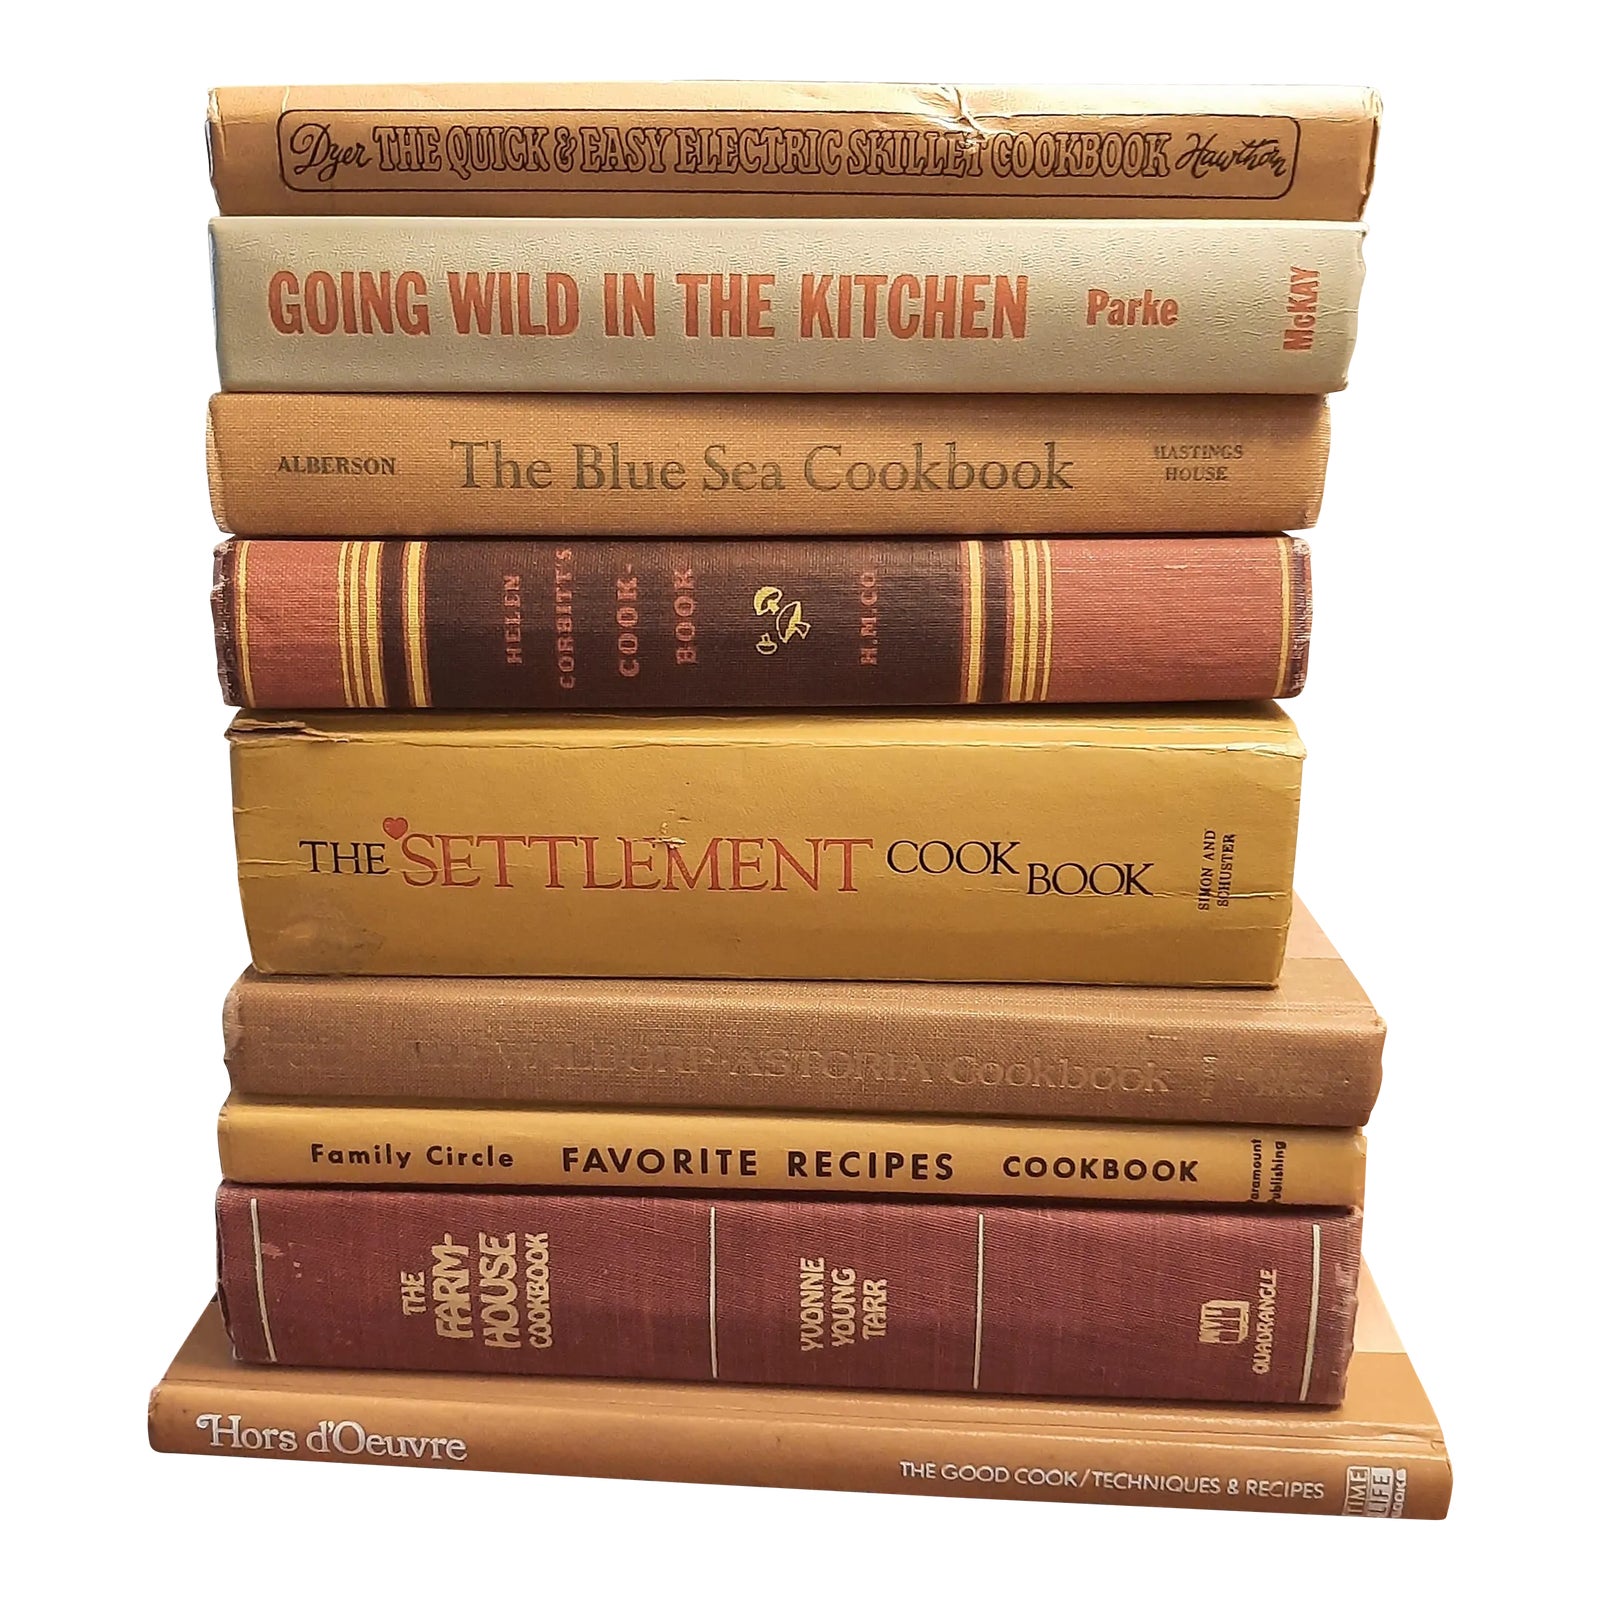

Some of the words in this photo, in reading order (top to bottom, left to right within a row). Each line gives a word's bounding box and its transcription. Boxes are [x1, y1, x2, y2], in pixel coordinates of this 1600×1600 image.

[290, 122, 373, 182] Dyer
[372, 125, 442, 173] THE
[446, 126, 551, 180] QUICK
[553, 126, 580, 173] &
[578, 127, 671, 174] EASY
[674, 128, 843, 176] ELECTRIC
[846, 129, 989, 178] SKILLET
[991, 130, 1171, 178] COOKBOOK
[1176, 131, 1288, 181] Hawthorn
[268, 270, 431, 336] GOING
[448, 271, 580, 337] WILD
[603, 272, 656, 337] IN
[677, 273, 776, 338] THE
[800, 274, 1029, 339] KITCHEN
[1086, 289, 1179, 328] Parke
[1283, 266, 1320, 351] McKAY
[277, 456, 395, 477] ALBERSON
[449, 439, 552, 491] The
[571, 443, 687, 491] Blue
[702, 444, 785, 492] Sea
[803, 442, 1075, 493] Cookbook
[1152, 443, 1245, 461] HASTINGS
[1165, 465, 1229, 483] HOUSE
[503, 575, 522, 665] HELEN
[556, 548, 575, 690] CORBITT'S
[617, 563, 640, 678] COOK-
[676, 568, 696, 666] BOOK
[300, 841, 389, 875] THE
[401, 834, 873, 894] SETTLEMENT
[886, 839, 1020, 876] COOK
[1026, 862, 1154, 897] BOOK
[1203, 829, 1218, 861] AND
[1217, 832, 1236, 908] SCHUSTER
[1198, 866, 1216, 911] SIMON
[947, 1053, 1170, 1093] Cookbook
[311, 1143, 411, 1169] Family
[427, 1144, 515, 1169] Circle
[562, 1147, 757, 1177] FAVORITE
[788, 1149, 955, 1181] RECIPES
[1002, 1154, 1199, 1183] COOKBOOK
[1246, 1138, 1262, 1204] aramount
[1268, 1141, 1287, 1205] ublishing
[402, 1271, 427, 1316] THE
[432, 1233, 474, 1341] FARM-
[479, 1232, 521, 1349] HOUSE
[524, 1232, 554, 1349] COOKBOOK
[800, 1257, 825, 1352] YVONNE
[829, 1267, 857, 1348] YOUNG
[862, 1278, 888, 1340] TARR
[1252, 1268, 1277, 1374] QUADRANGLE
[195, 1412, 300, 1454] Hors
[305, 1419, 468, 1463] d'Oeuvre
[900, 1460, 937, 1480] THE
[941, 1462, 1010, 1486] GOOD
[1226, 1480, 1240, 1495] &
[1245, 1481, 1325, 1500] RECIPES
[1347, 1470, 1368, 1515] TIME
[1368, 1474, 1392, 1515] LIFE
